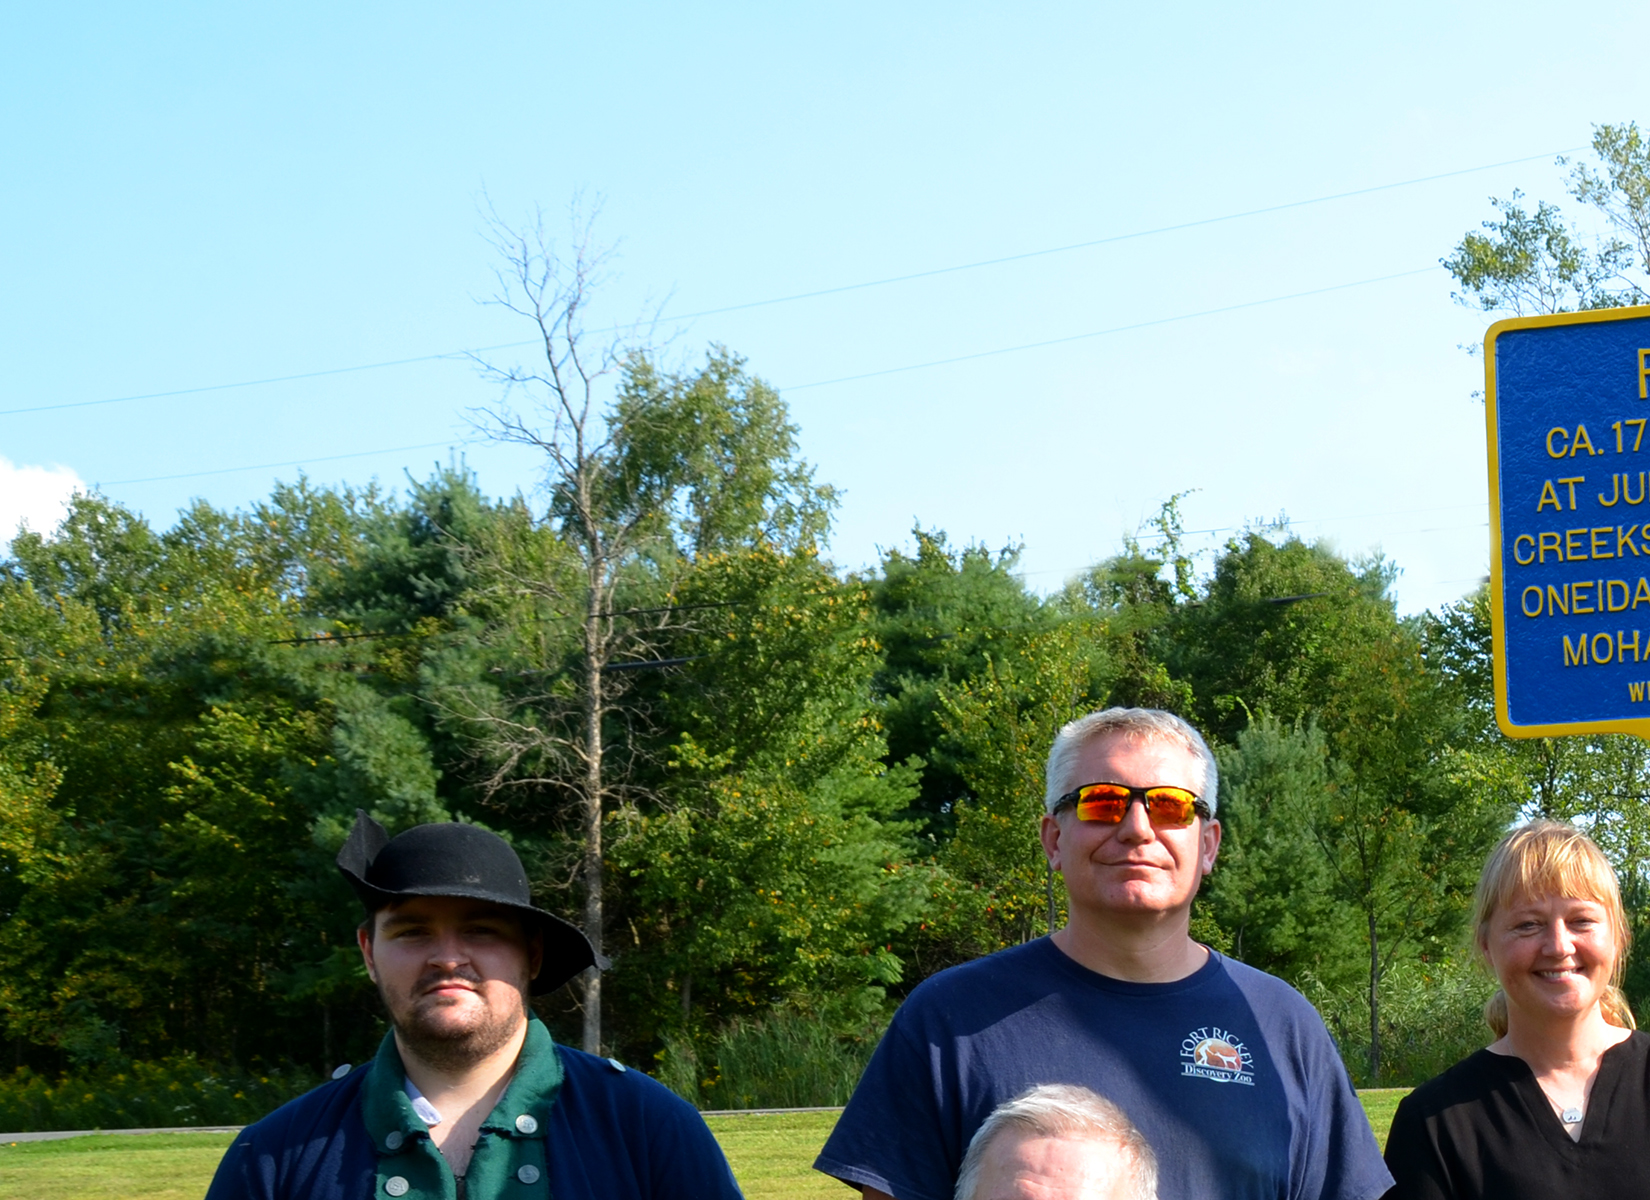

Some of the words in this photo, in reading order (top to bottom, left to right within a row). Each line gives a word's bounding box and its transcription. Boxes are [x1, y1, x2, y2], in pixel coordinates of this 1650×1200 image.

[1546, 424, 1604, 459] CA.
[1537, 476, 1585, 512] AT
[1180, 1027, 1208, 1058] FORT
[1212, 1027, 1254, 1069] RICKEY
[1184, 1064, 1232, 1080] Discovery
[1233, 1071, 1252, 1083] Zoo
